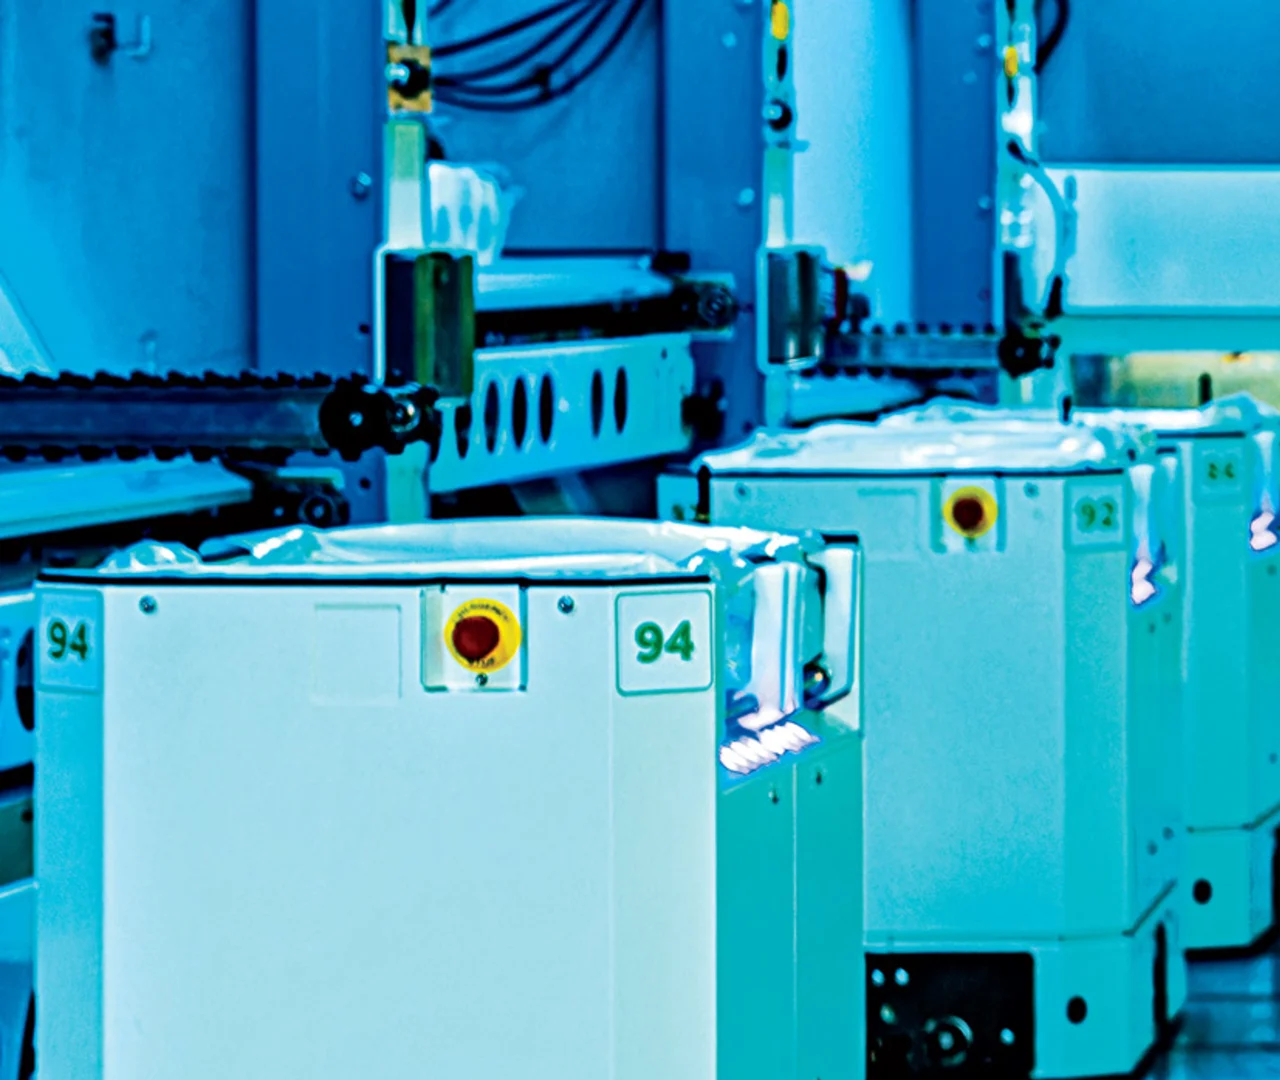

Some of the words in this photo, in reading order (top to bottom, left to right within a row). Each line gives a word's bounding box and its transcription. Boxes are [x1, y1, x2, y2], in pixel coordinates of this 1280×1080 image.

[1078, 499, 1117, 531] 92
[50, 620, 89, 661] 94
[634, 619, 696, 665] 94
